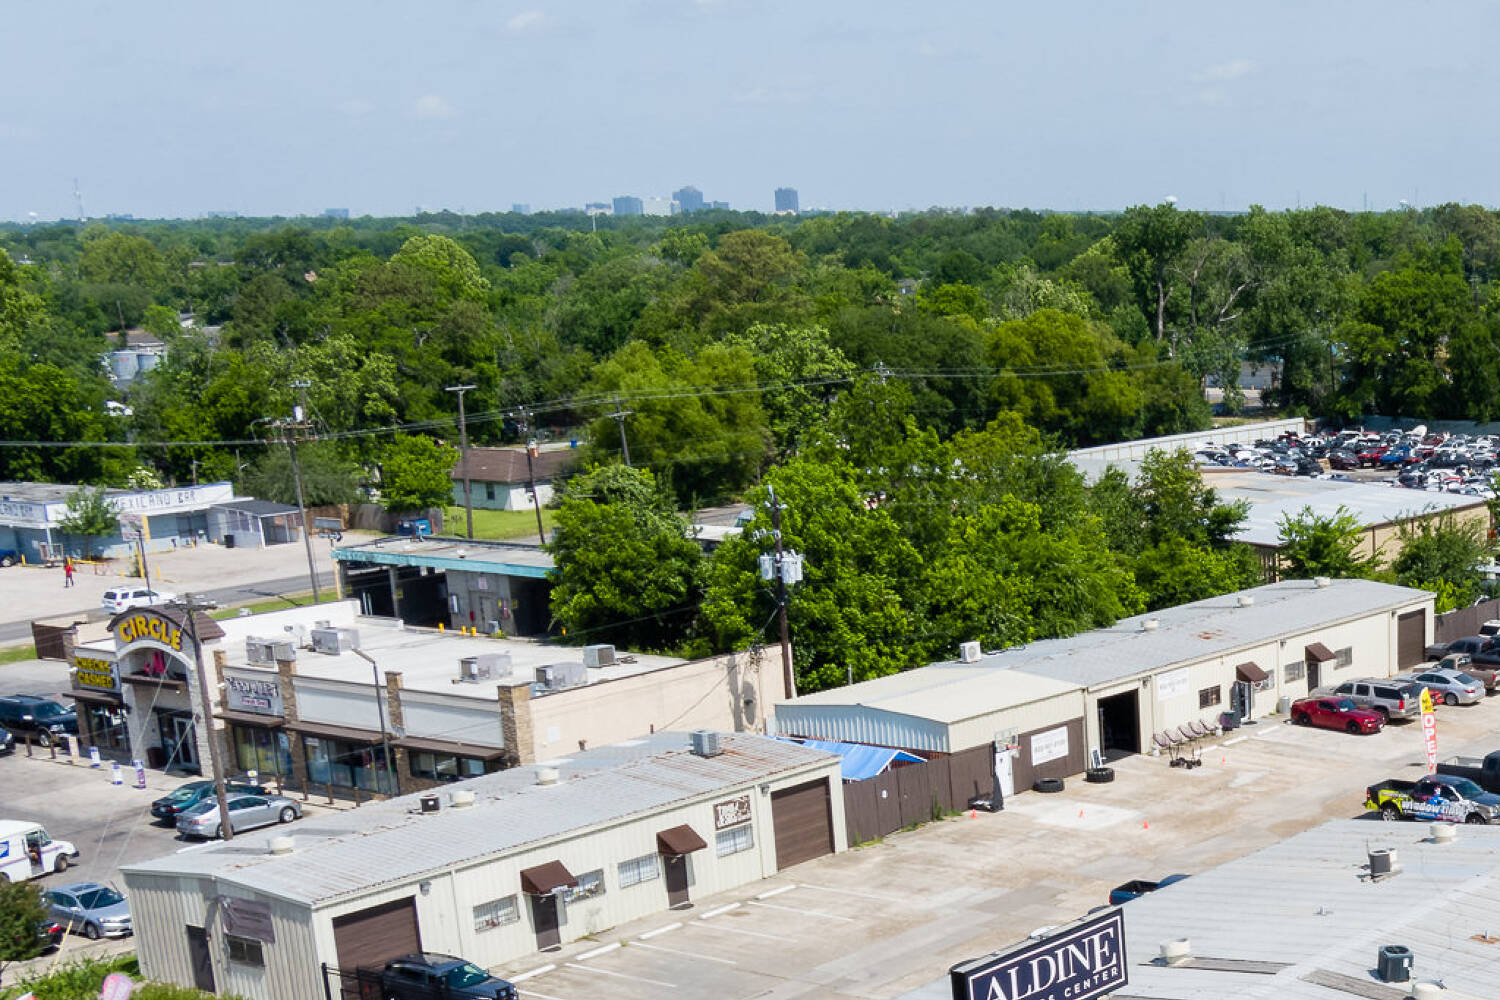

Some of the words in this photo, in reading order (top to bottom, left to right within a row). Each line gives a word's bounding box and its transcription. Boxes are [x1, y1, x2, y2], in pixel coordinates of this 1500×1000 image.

[119, 616, 183, 650] CIRCLE
[77, 671, 115, 689] CASHED
[1064, 966, 1119, 997] CENTER
